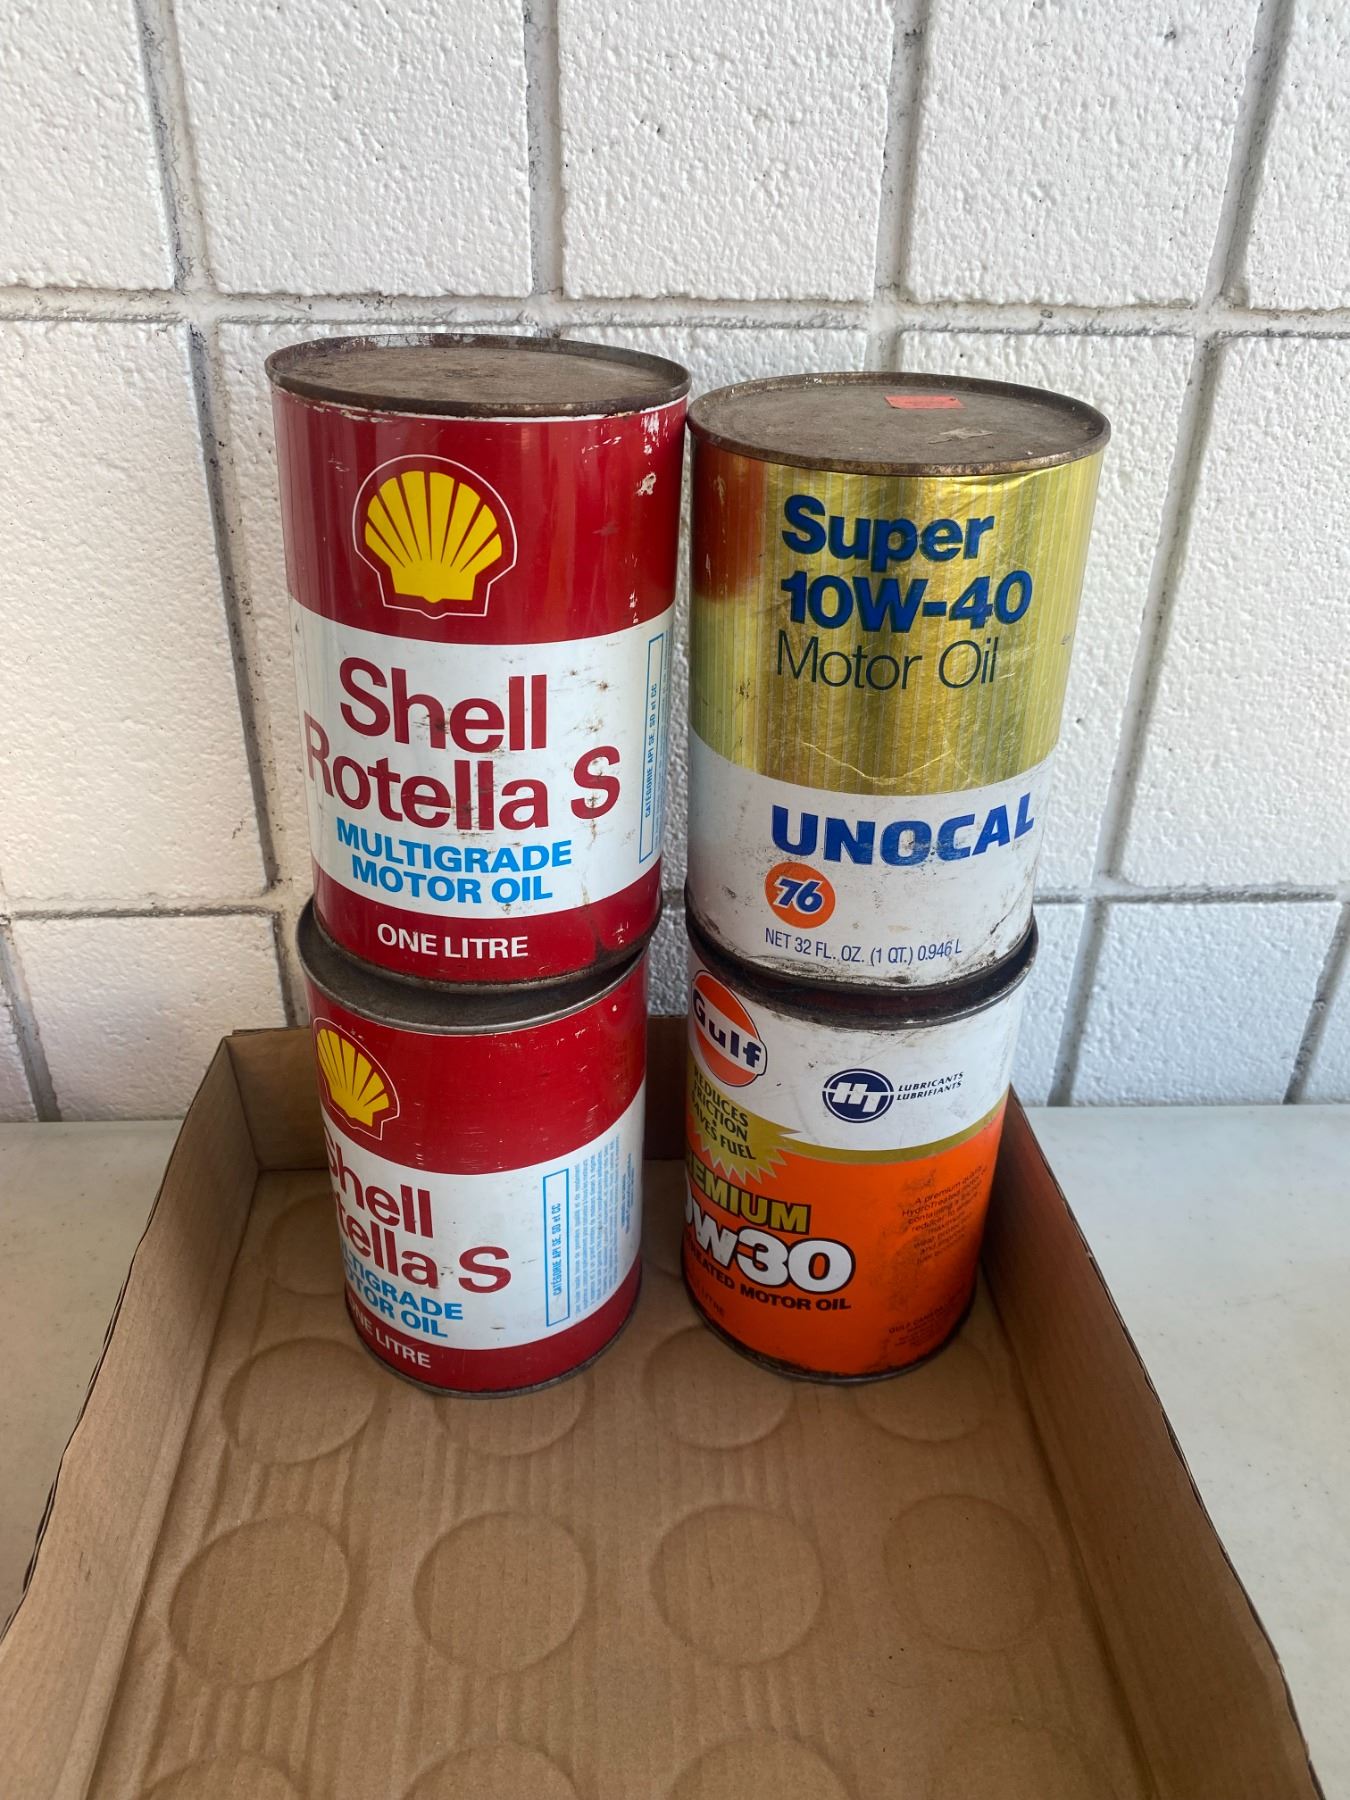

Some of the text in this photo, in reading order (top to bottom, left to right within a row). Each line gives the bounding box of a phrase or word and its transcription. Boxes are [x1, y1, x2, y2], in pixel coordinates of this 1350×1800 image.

[781, 494, 995, 573] Super
[780, 569, 1033, 634] 10W-40
[777, 629, 997, 691] Motor Oil
[339, 657, 547, 753] Shell
[304, 711, 549, 831] Rotella
[571, 746, 621, 819] S
[336, 817, 572, 874] MULTIGRADE
[771, 792, 1036, 867] UNOCAL
[351, 855, 553, 904] MOTOR OIL
[773, 879, 823, 915] 76
[376, 924, 529, 960] ONE LITRE
[765, 927, 963, 967] NET 32 FL. OZ. (1 QT.) 0.946 L
[693, 993, 762, 1068] Gulf
[694, 1065, 748, 1127] REDUCES
[896, 1081, 962, 1101] LUBRIFIANTS
[898, 1071, 964, 1093] LUBRICANTS
[720, 1135, 756, 1161] FUEL
[323, 1125, 433, 1239] Shell
[551, 1203, 560, 1214] CC
[689, 1149, 811, 1235] EMIUM
[335, 1191, 511, 1294] tella S
[551, 1246, 560, 1259] API
[345, 1259, 448, 1338] OTOR OIL
[740, 1283, 811, 1311] MOTOR
[816, 1298, 852, 1311] OIL
[375, 1328, 431, 1369] LITRE
